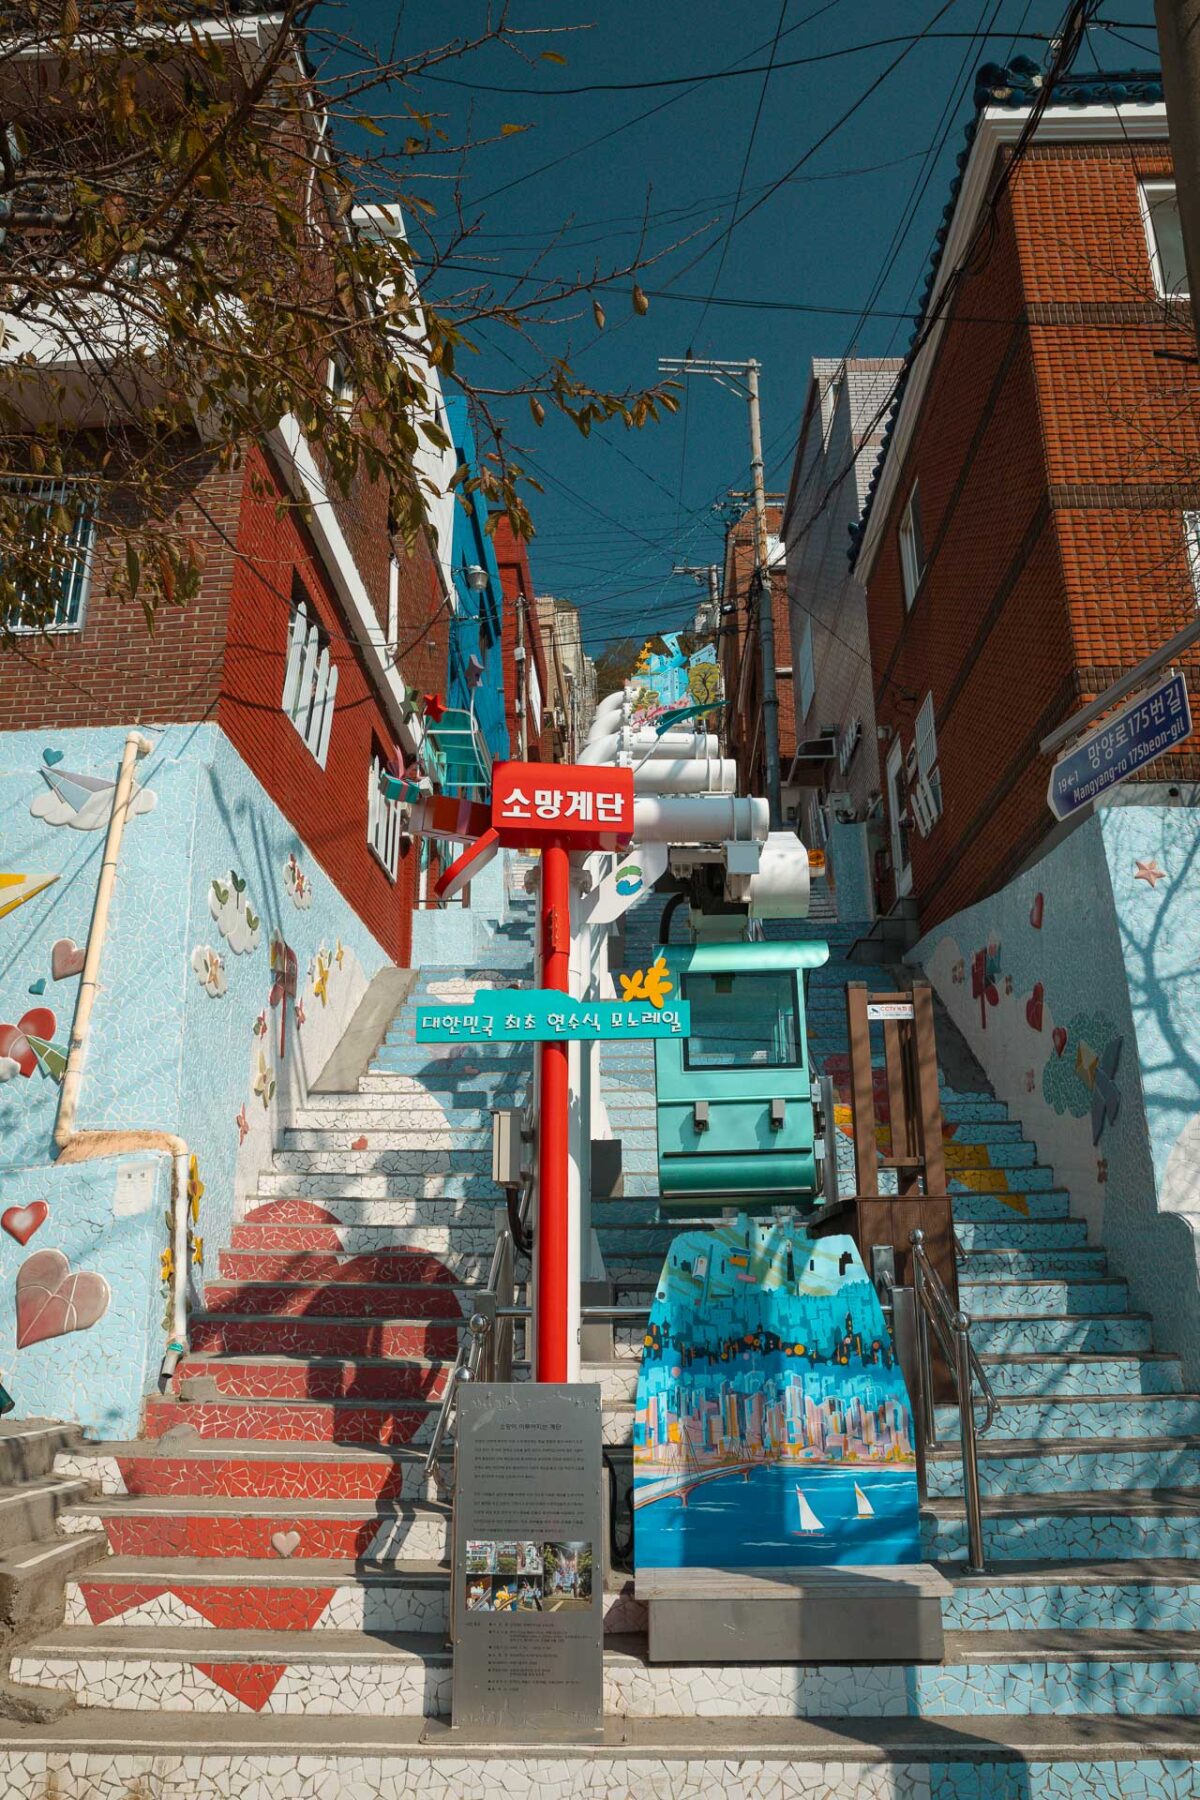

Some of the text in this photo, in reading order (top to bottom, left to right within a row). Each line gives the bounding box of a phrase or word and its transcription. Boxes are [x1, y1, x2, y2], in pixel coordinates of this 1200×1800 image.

[1088, 684, 1182, 769] 망양로175번길
[1073, 716, 1185, 802] Mangyang-ro 175beon-gil
[501, 788, 625, 822] 소망계단
[421, 1014, 494, 1038] 대한민국
[504, 1013, 536, 1030] 최초
[611, 1011, 683, 1034] 모노레일
